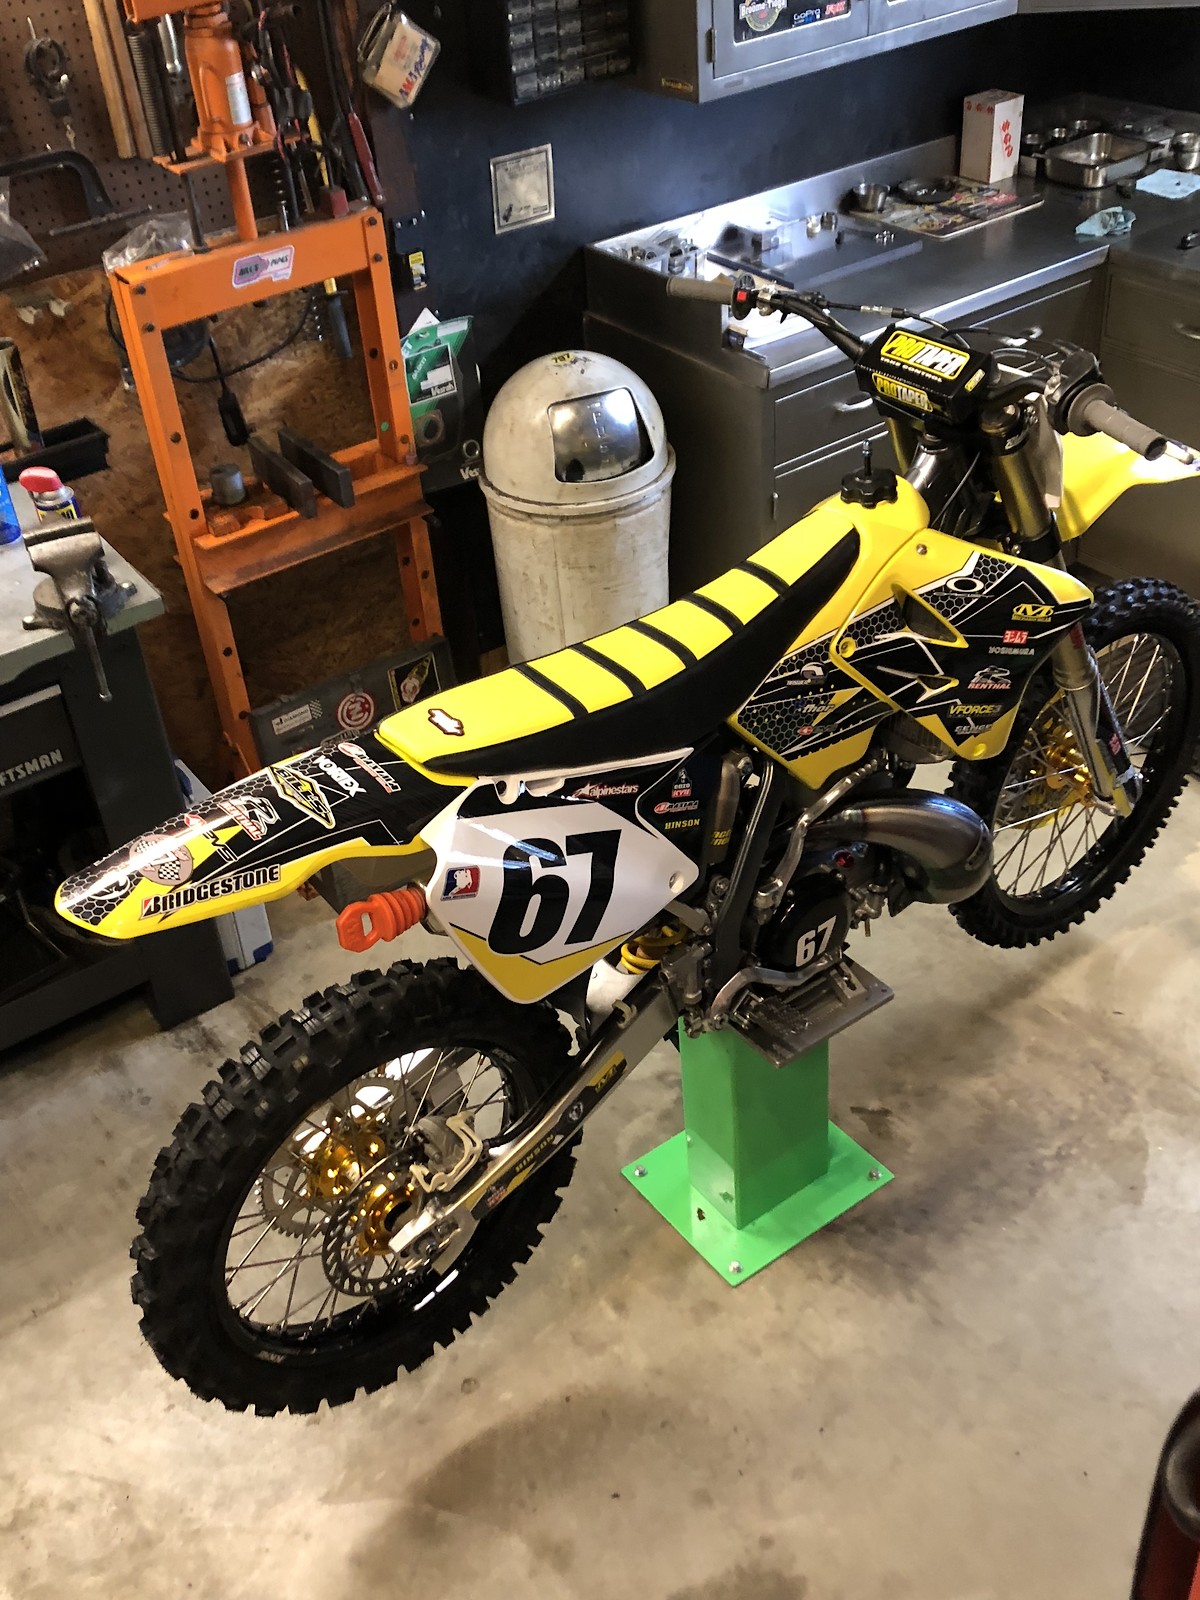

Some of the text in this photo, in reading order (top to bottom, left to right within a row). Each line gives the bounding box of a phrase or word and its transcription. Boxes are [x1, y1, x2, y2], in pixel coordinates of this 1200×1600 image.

[793, 8, 820, 20] GoPro
[902, 364, 943, 383] CONTROL
[967, 682, 1011, 690] RENTHAL
[589, 784, 639, 799] alpinestars
[664, 818, 701, 830] HINSON
[142, 864, 280, 917] BRIDGESTONE
[487, 828, 623, 955] 67
[795, 914, 838, 968] 67
